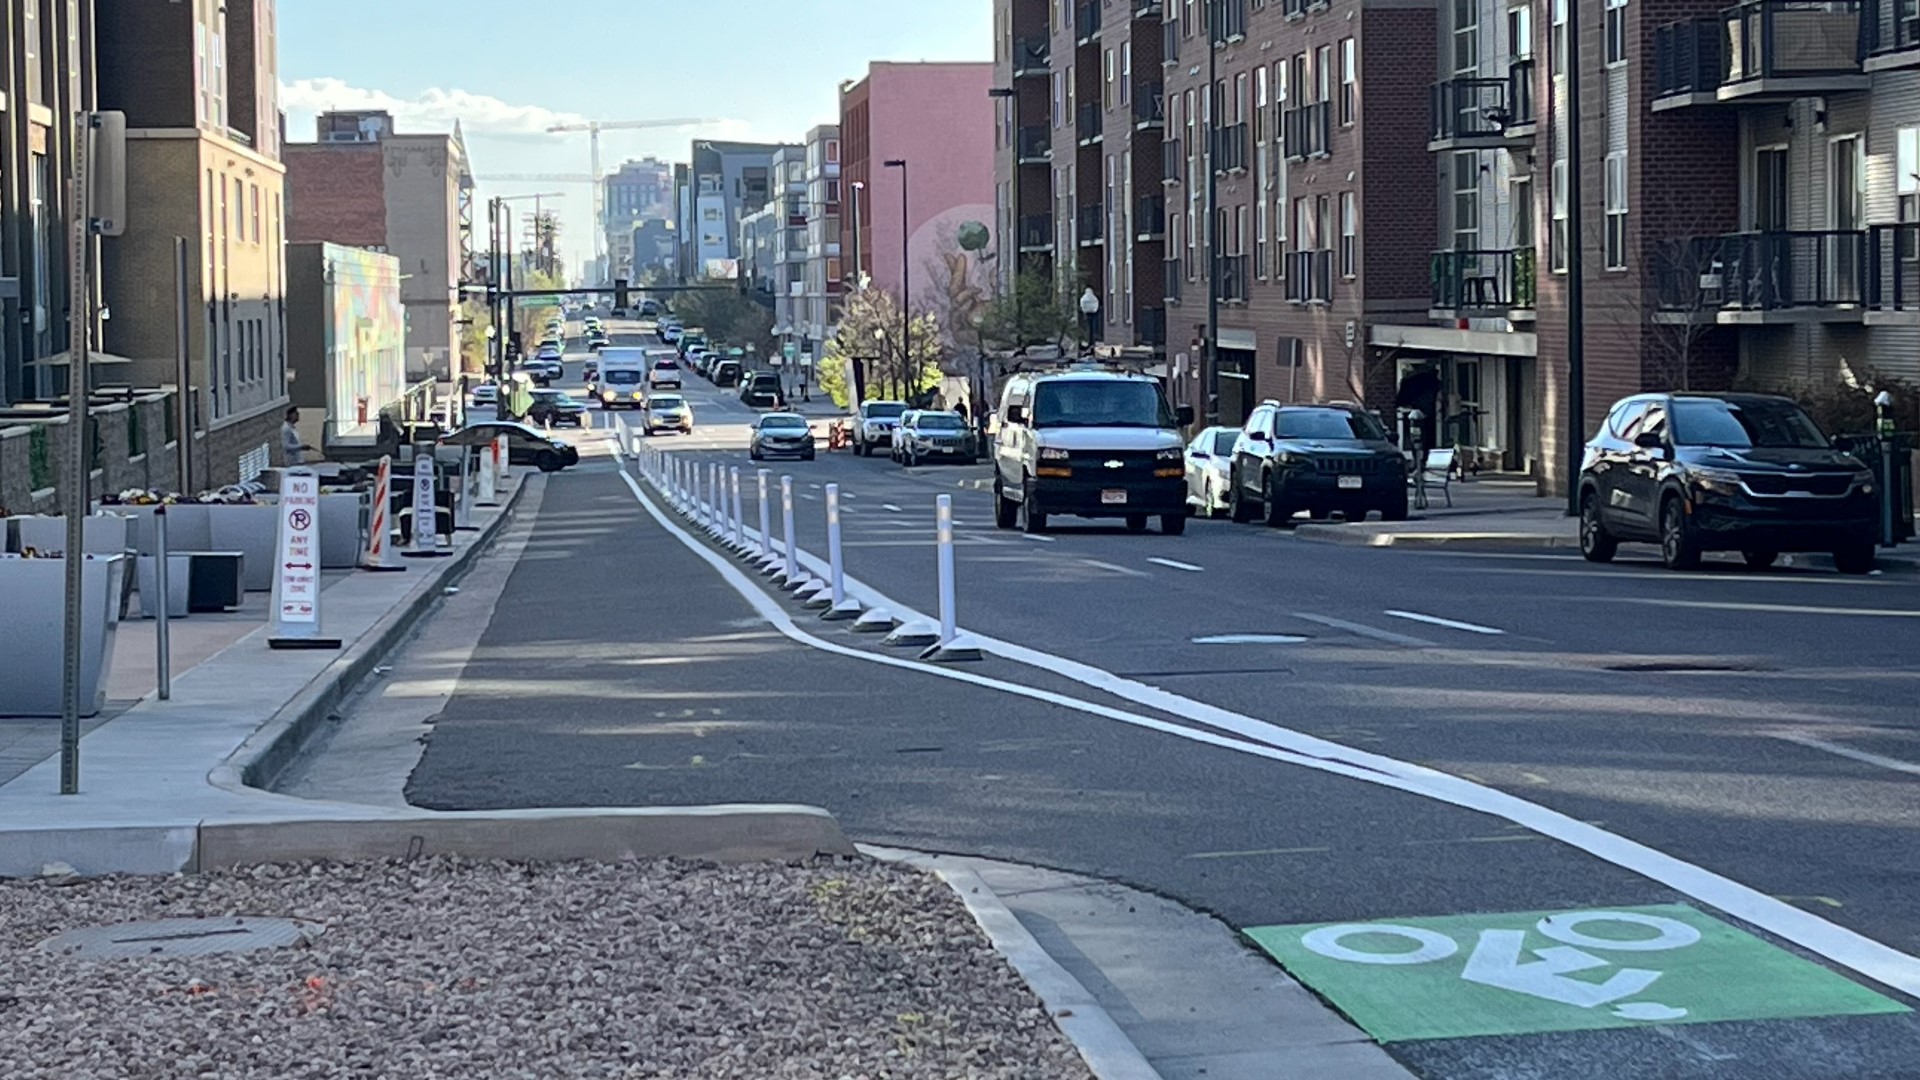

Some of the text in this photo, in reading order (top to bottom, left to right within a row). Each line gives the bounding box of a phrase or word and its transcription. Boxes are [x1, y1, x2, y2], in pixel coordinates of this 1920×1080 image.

[293, 482, 308, 494] NO
[284, 496, 316, 505] PARKING
[290, 535, 308, 544] ANY
[289, 546, 309, 557] TIME
